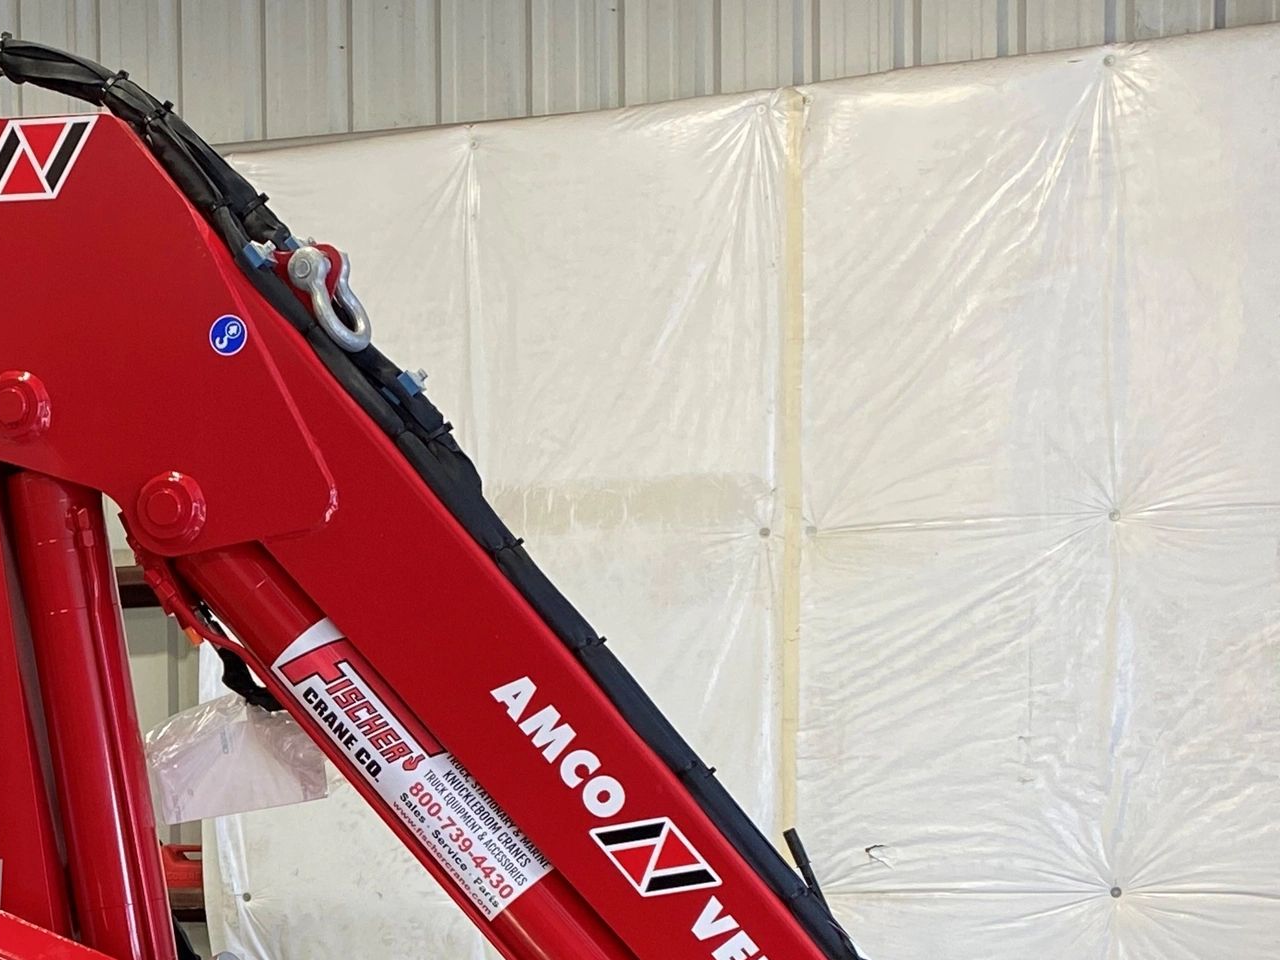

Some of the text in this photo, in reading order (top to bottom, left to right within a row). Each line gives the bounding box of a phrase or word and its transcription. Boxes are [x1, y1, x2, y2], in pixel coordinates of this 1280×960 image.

[278, 637, 448, 764] FISCHER
[300, 686, 387, 783] CRANE CO.
[489, 676, 626, 818] AMCO
[391, 799, 493, 915] www.fischercrane.com
[398, 791, 501, 908] Sales Service Parts
[407, 779, 515, 900] 800-739-4430
[423, 769, 447, 795] TRUCK
[441, 791, 482, 835] EQUIPMENT
[482, 837, 528, 887] ACCESSORIES
[442, 768, 531, 868] KNUCKLEBOOM CRANES
[469, 779, 515, 829] STATIONARY
[519, 835, 550, 869] MARINE
